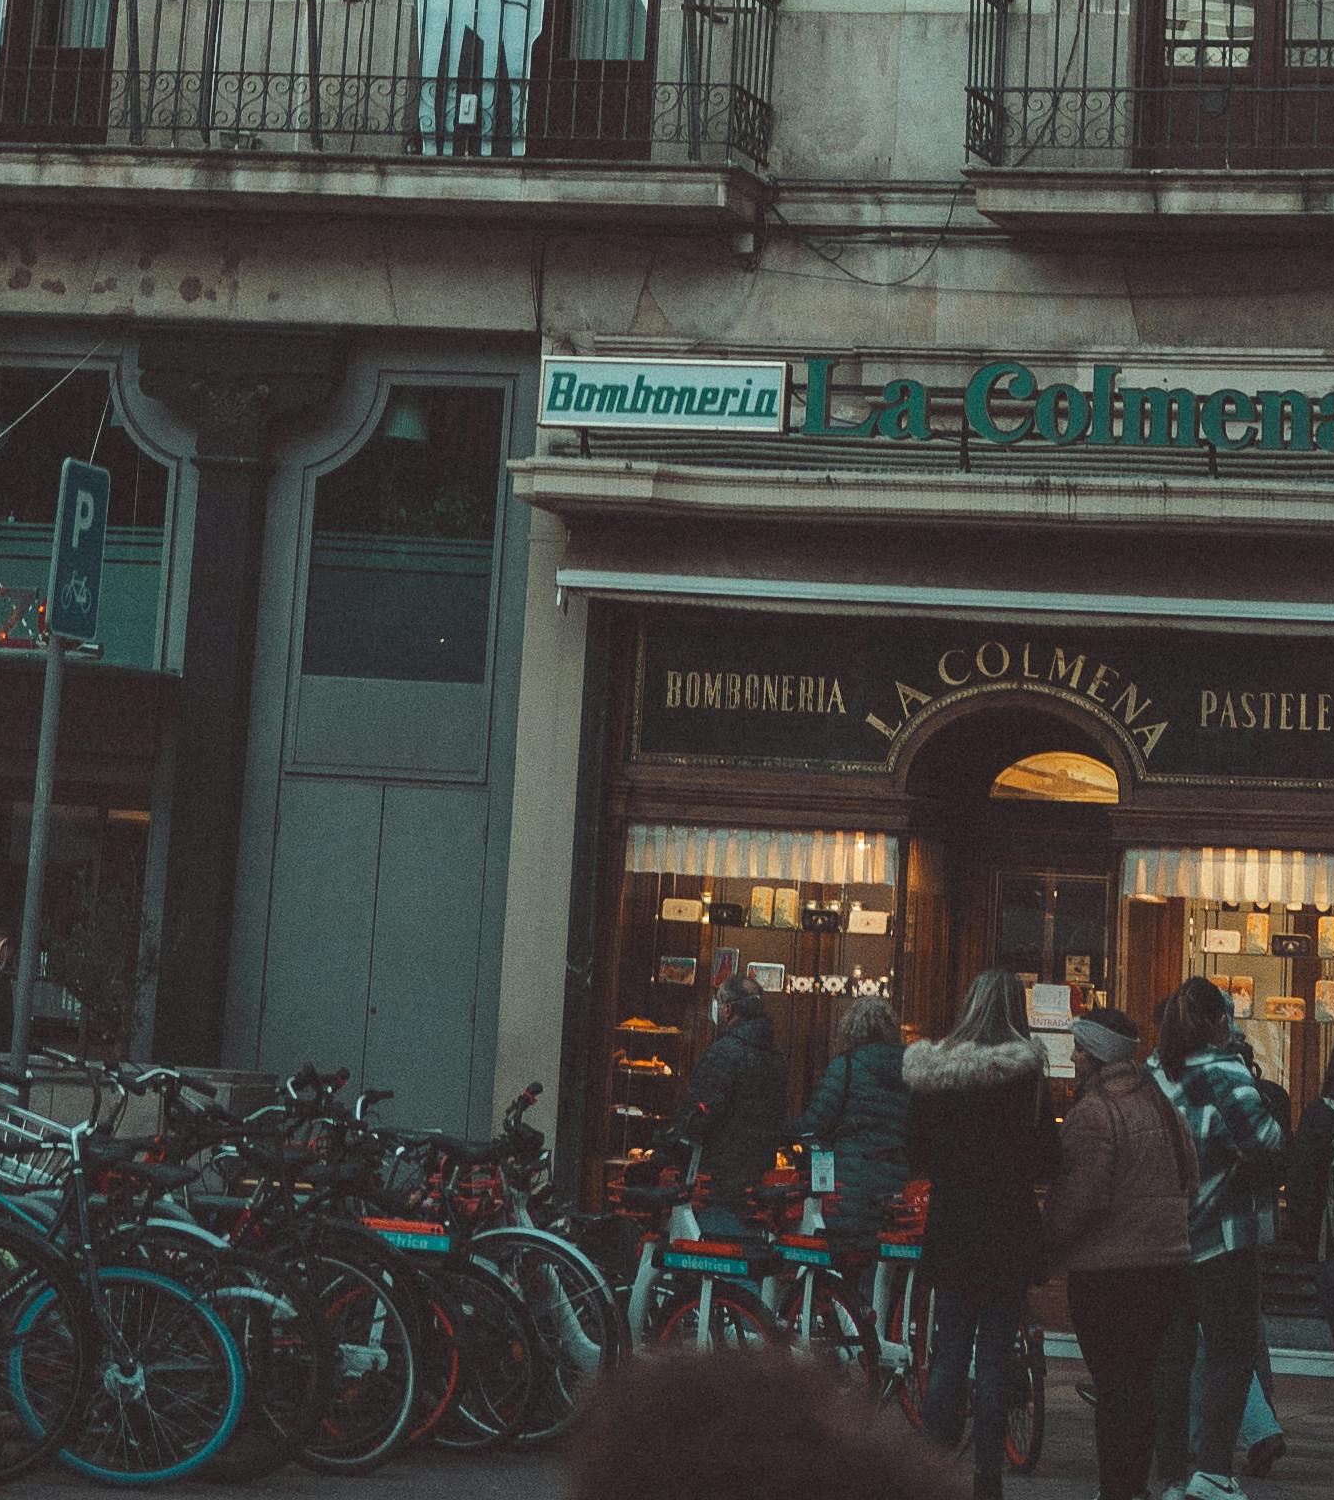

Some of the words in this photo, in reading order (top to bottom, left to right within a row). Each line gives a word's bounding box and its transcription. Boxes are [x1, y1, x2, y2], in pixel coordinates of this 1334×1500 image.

[546, 371, 779, 418] Bomboneria
[800, 357, 932, 440] La
[72, 489, 95, 549] P
[666, 671, 846, 714] BOMBONERIA
[865, 681, 933, 741] LA
[938, 642, 1169, 759] COLMENA
